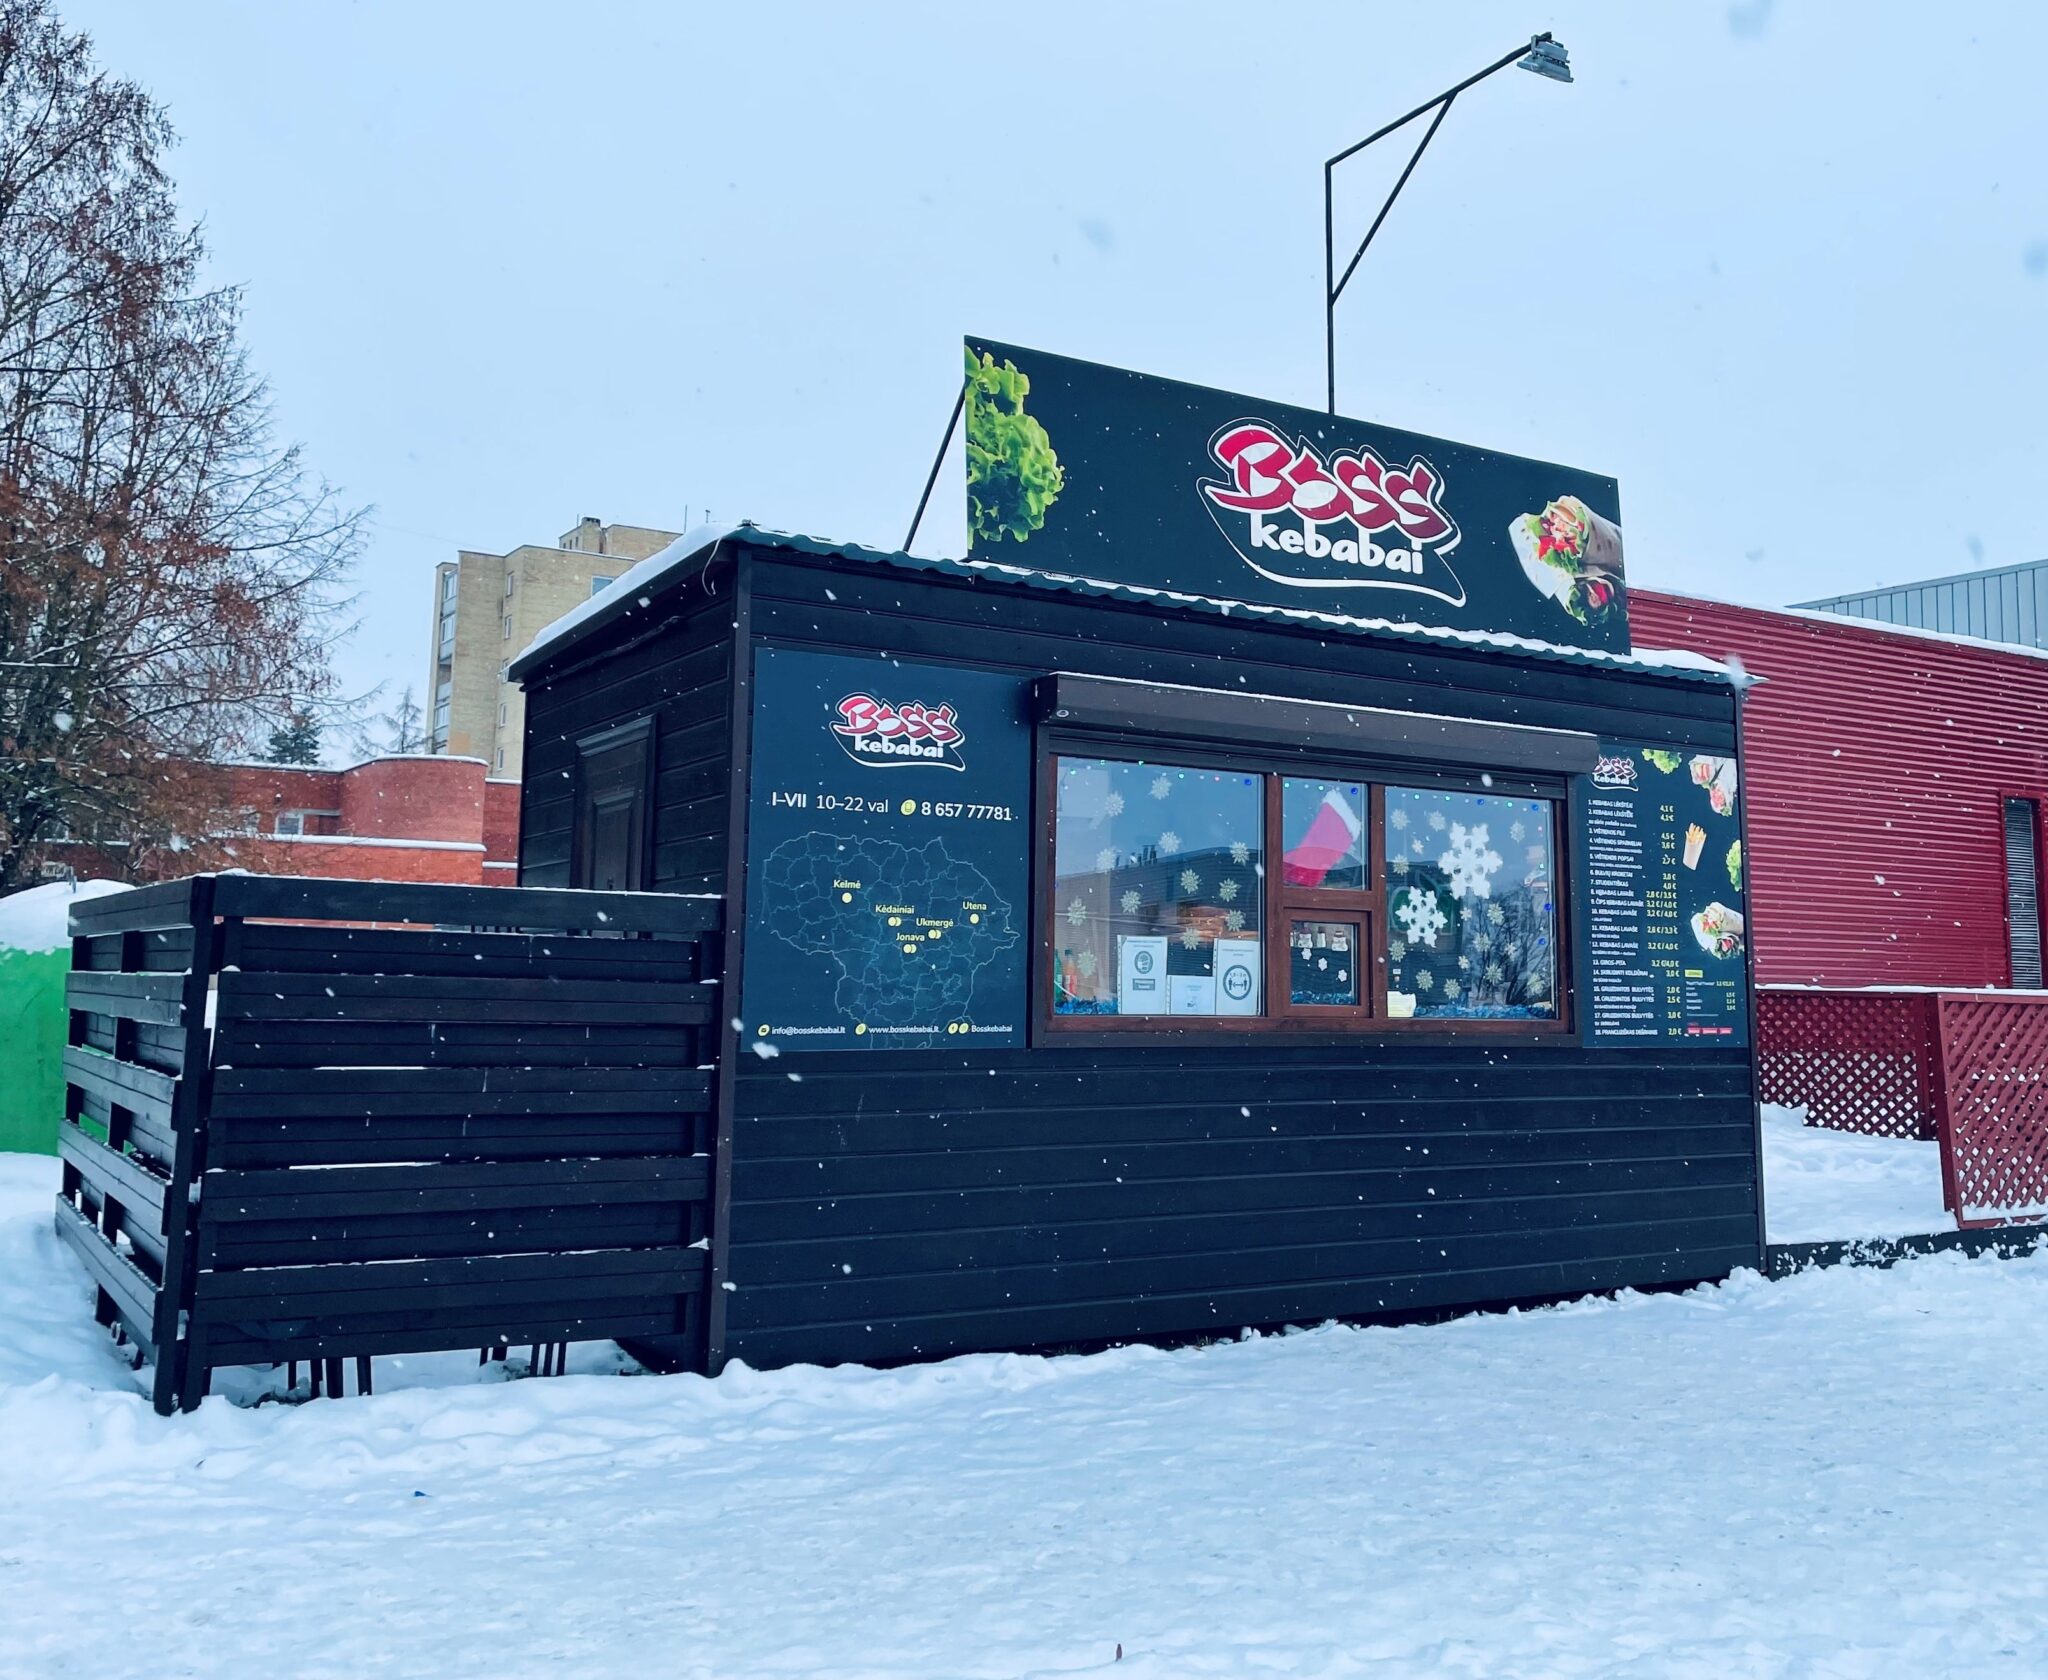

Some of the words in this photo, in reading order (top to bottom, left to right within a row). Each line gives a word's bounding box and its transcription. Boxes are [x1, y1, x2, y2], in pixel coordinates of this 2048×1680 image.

[1250, 511, 1424, 575] kebabai
[854, 735, 944, 758] kebabai
[867, 799, 889, 814] val
[921, 802, 931, 815] 8
[935, 802, 961, 818] 657
[967, 804, 1011, 821] 77781
[962, 902, 987, 910] Utena
[896, 933, 925, 942] Jonava
